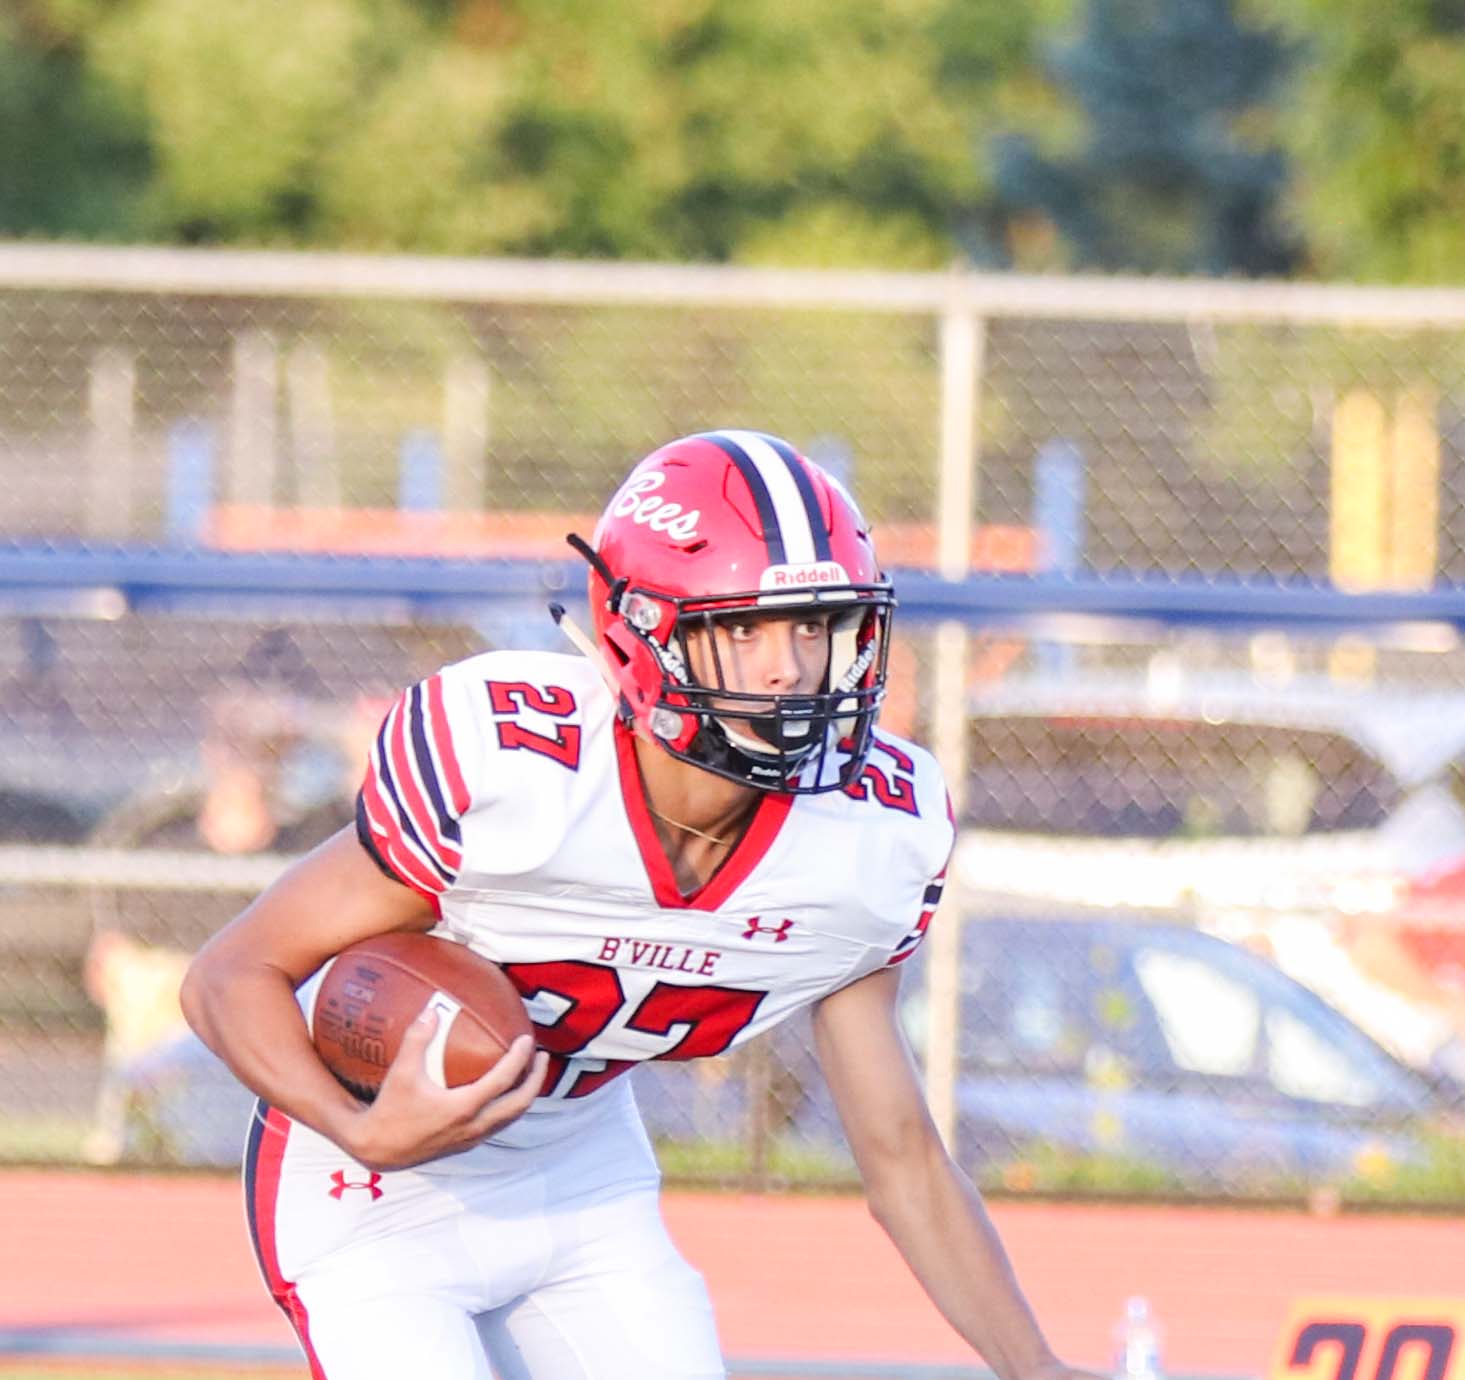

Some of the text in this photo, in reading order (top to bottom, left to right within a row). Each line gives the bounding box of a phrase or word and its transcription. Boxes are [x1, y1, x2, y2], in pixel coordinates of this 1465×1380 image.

[613, 471, 700, 540] Bees
[774, 567, 839, 586] Riddell
[484, 679, 581, 772] 27
[598, 937, 721, 976] B'VILLE
[500, 958, 770, 1099] 27
